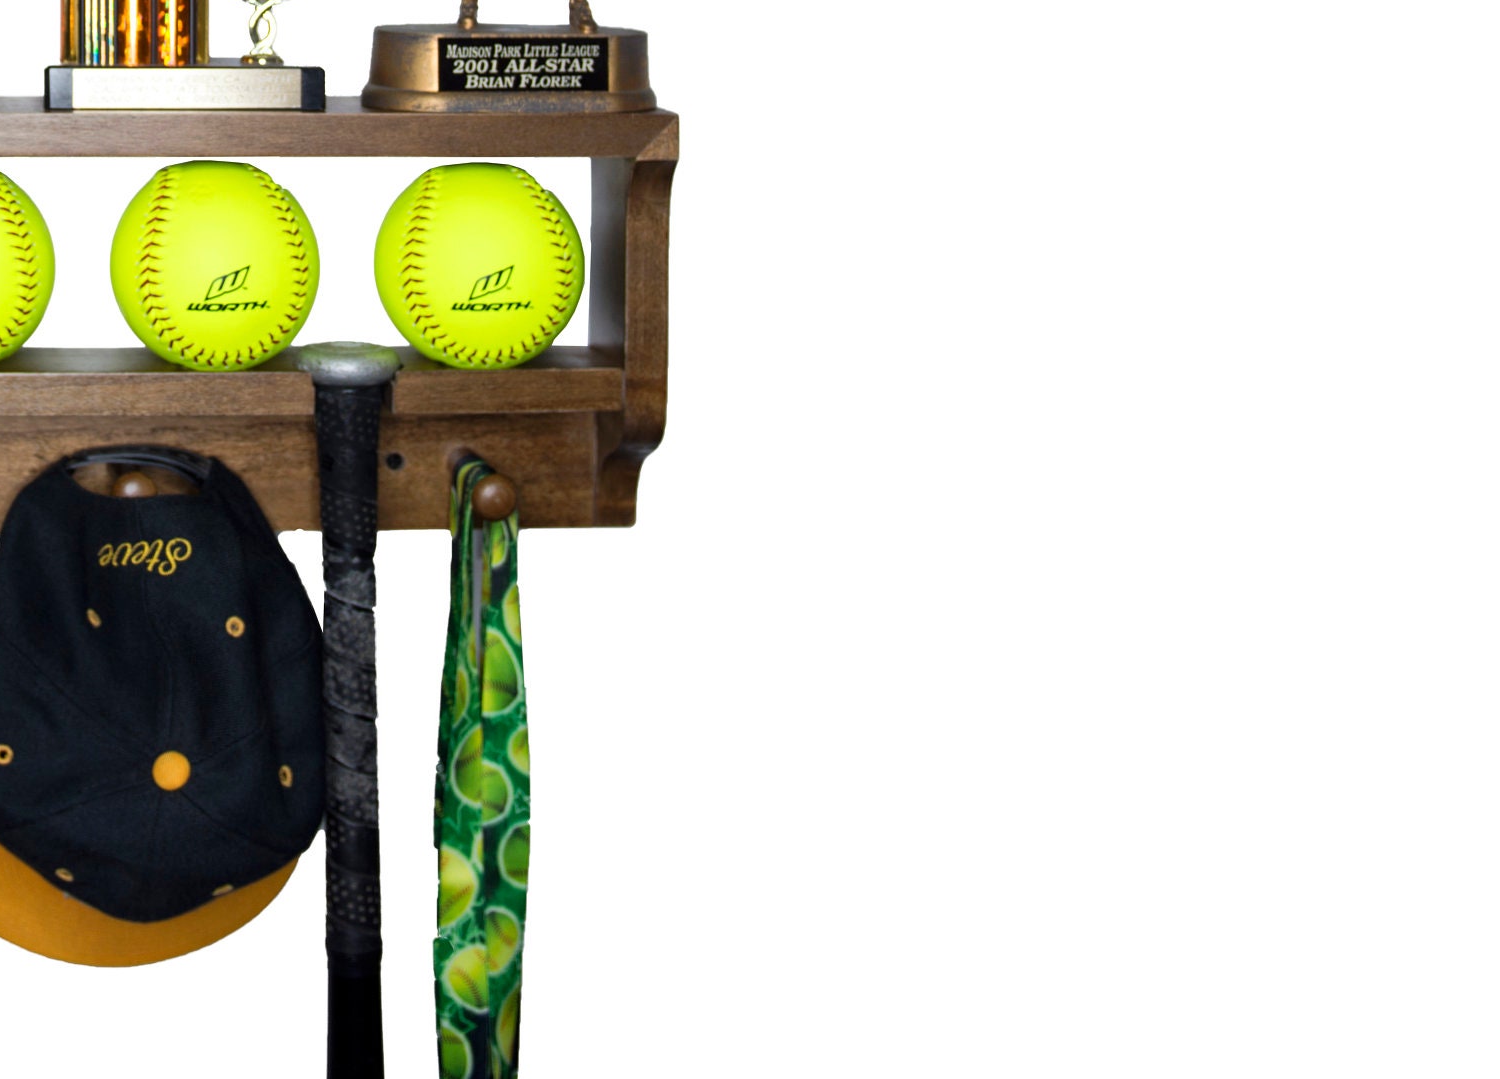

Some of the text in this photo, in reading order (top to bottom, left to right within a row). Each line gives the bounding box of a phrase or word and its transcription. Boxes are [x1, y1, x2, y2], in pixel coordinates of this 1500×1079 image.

[446, 42, 600, 58] MADISON PARK LITTLE LEAGUE
[453, 58, 594, 73] 2001 ALL-STAR
[465, 73, 582, 89] BRIAN FLOREK
[186, 300, 268, 312] WORTH
[451, 300, 532, 312] WORTH
[97, 537, 192, 576] Steve
